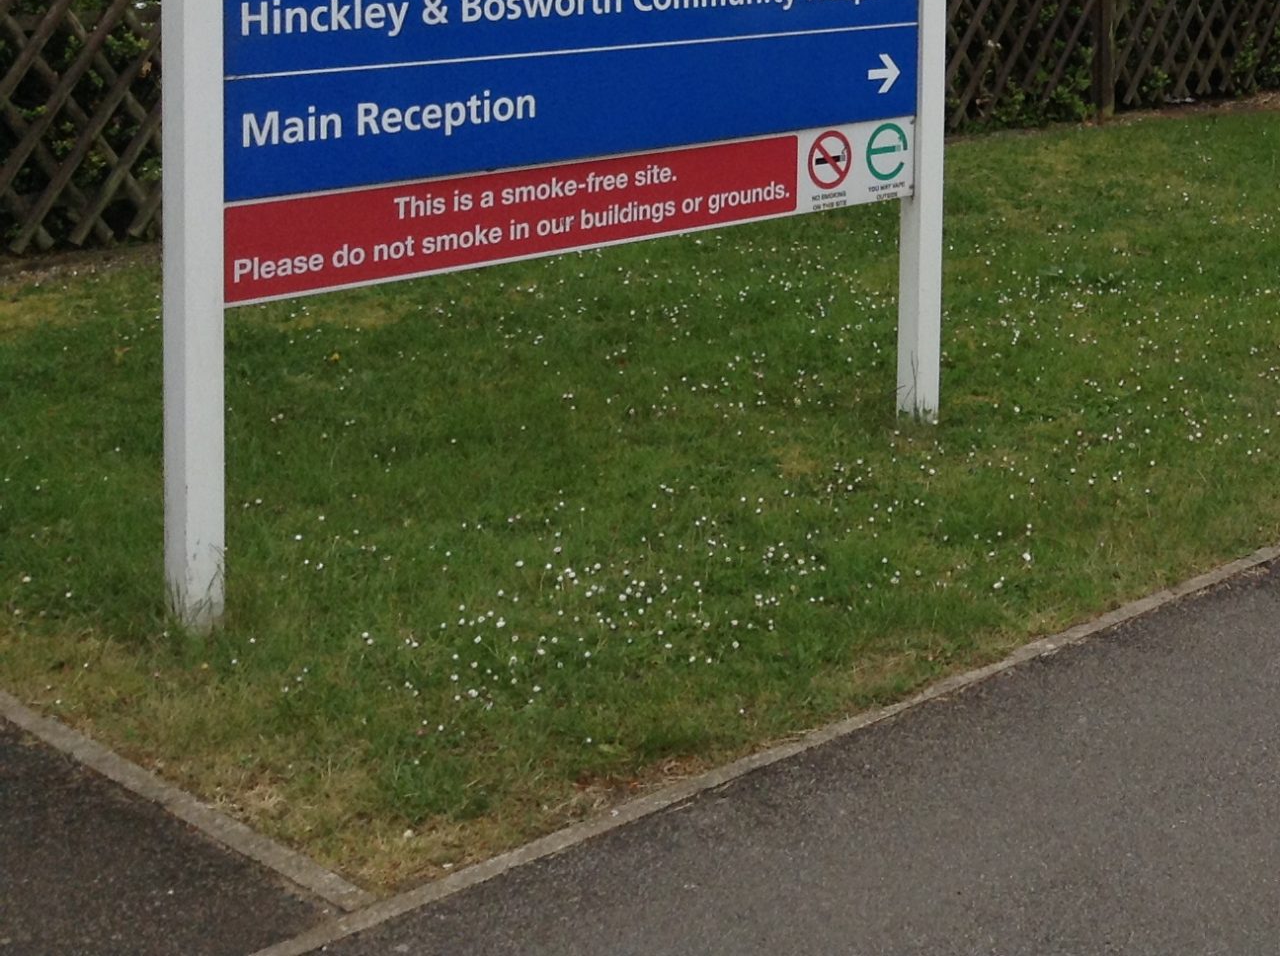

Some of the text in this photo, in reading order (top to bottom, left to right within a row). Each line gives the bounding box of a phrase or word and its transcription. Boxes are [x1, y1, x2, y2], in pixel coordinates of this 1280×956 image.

[242, 90, 536, 148] Main Reception
[393, 164, 677, 219] This is a smoke-free site.
[233, 180, 791, 283] Please do not smoke in our buildings or grounds.
